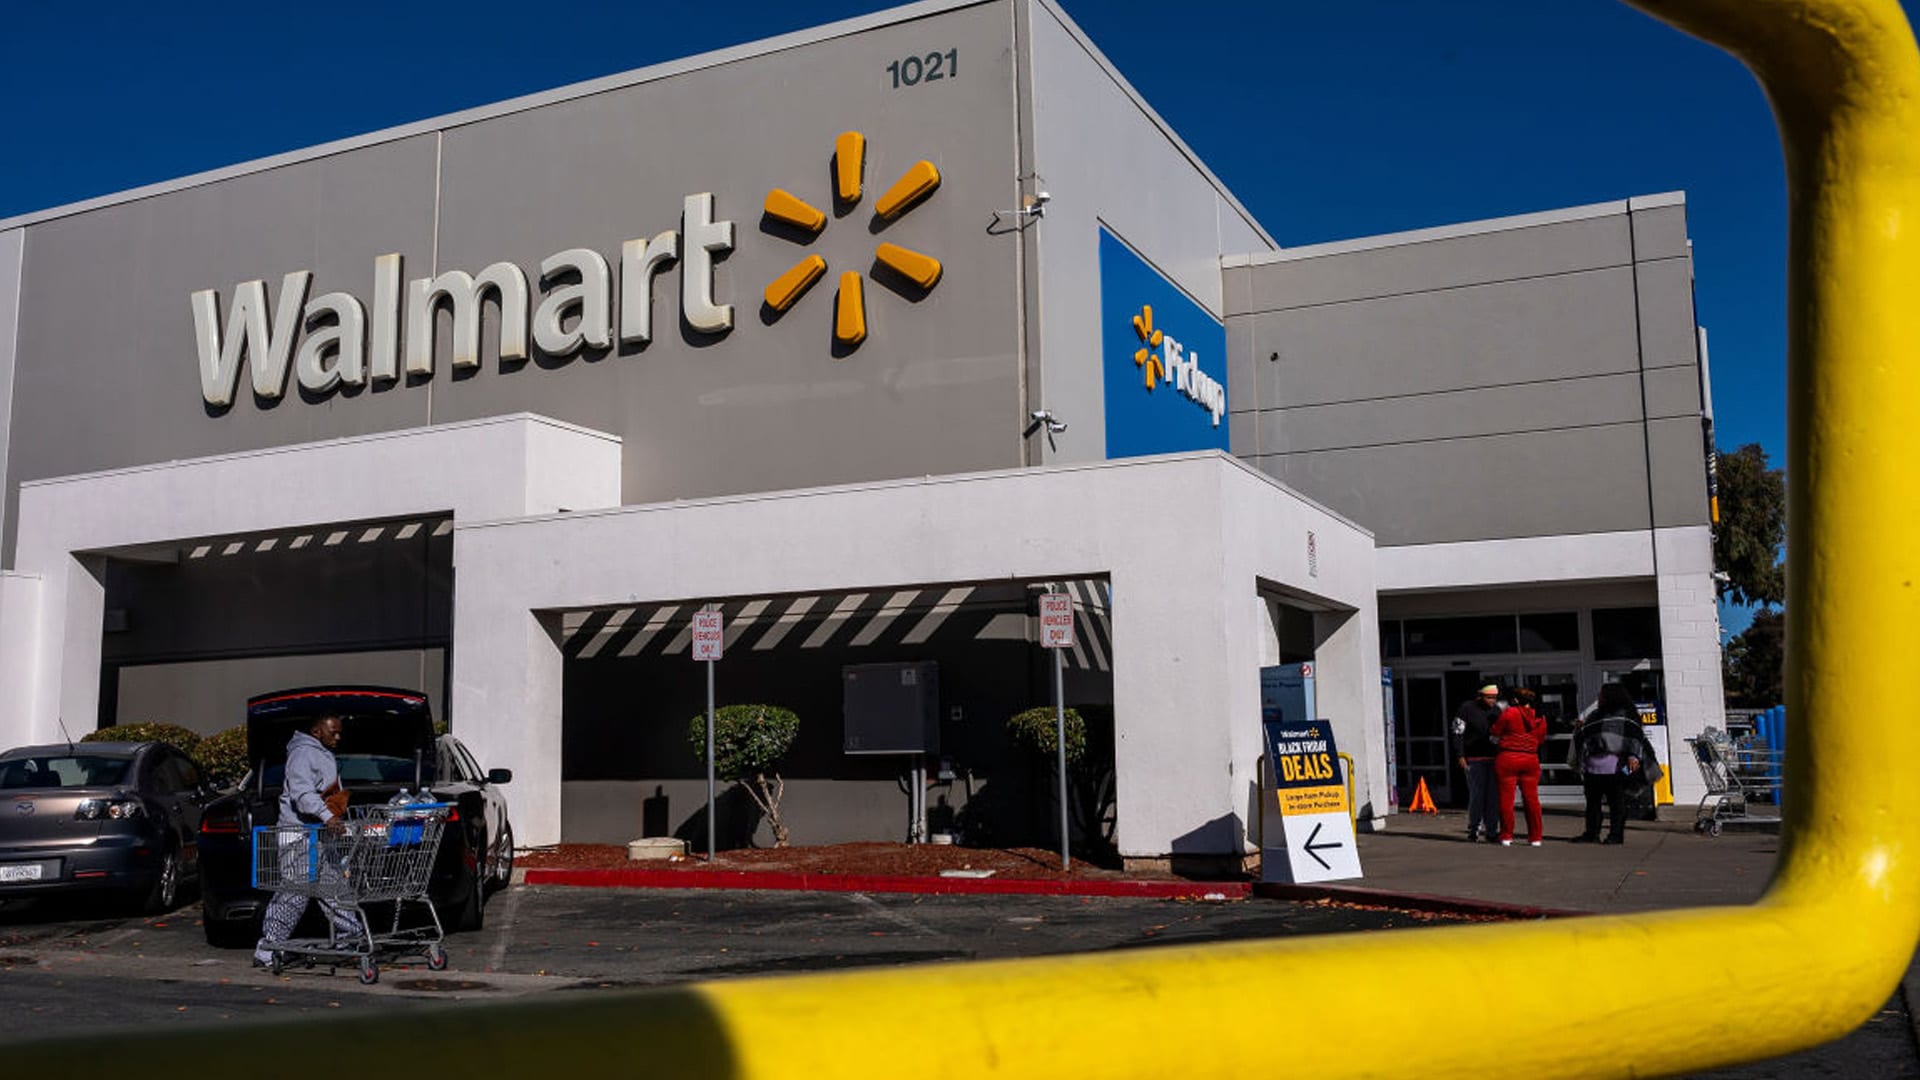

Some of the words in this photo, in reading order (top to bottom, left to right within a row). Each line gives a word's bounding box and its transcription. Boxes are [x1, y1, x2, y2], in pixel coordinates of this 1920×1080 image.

[886, 48, 957, 89] 1021
[191, 192, 735, 408] Walmart
[1163, 335, 1225, 426] Pickup
[1046, 601, 1067, 611] POLICE
[1044, 615, 1071, 625] VEHICLES
[1641, 713, 1657, 724] ALS
[1280, 730, 1309, 738] Walmart
[1278, 742, 1302, 754] BLACK
[1302, 740, 1326, 752] FRIDAY
[1281, 753, 1333, 781] DEALS
